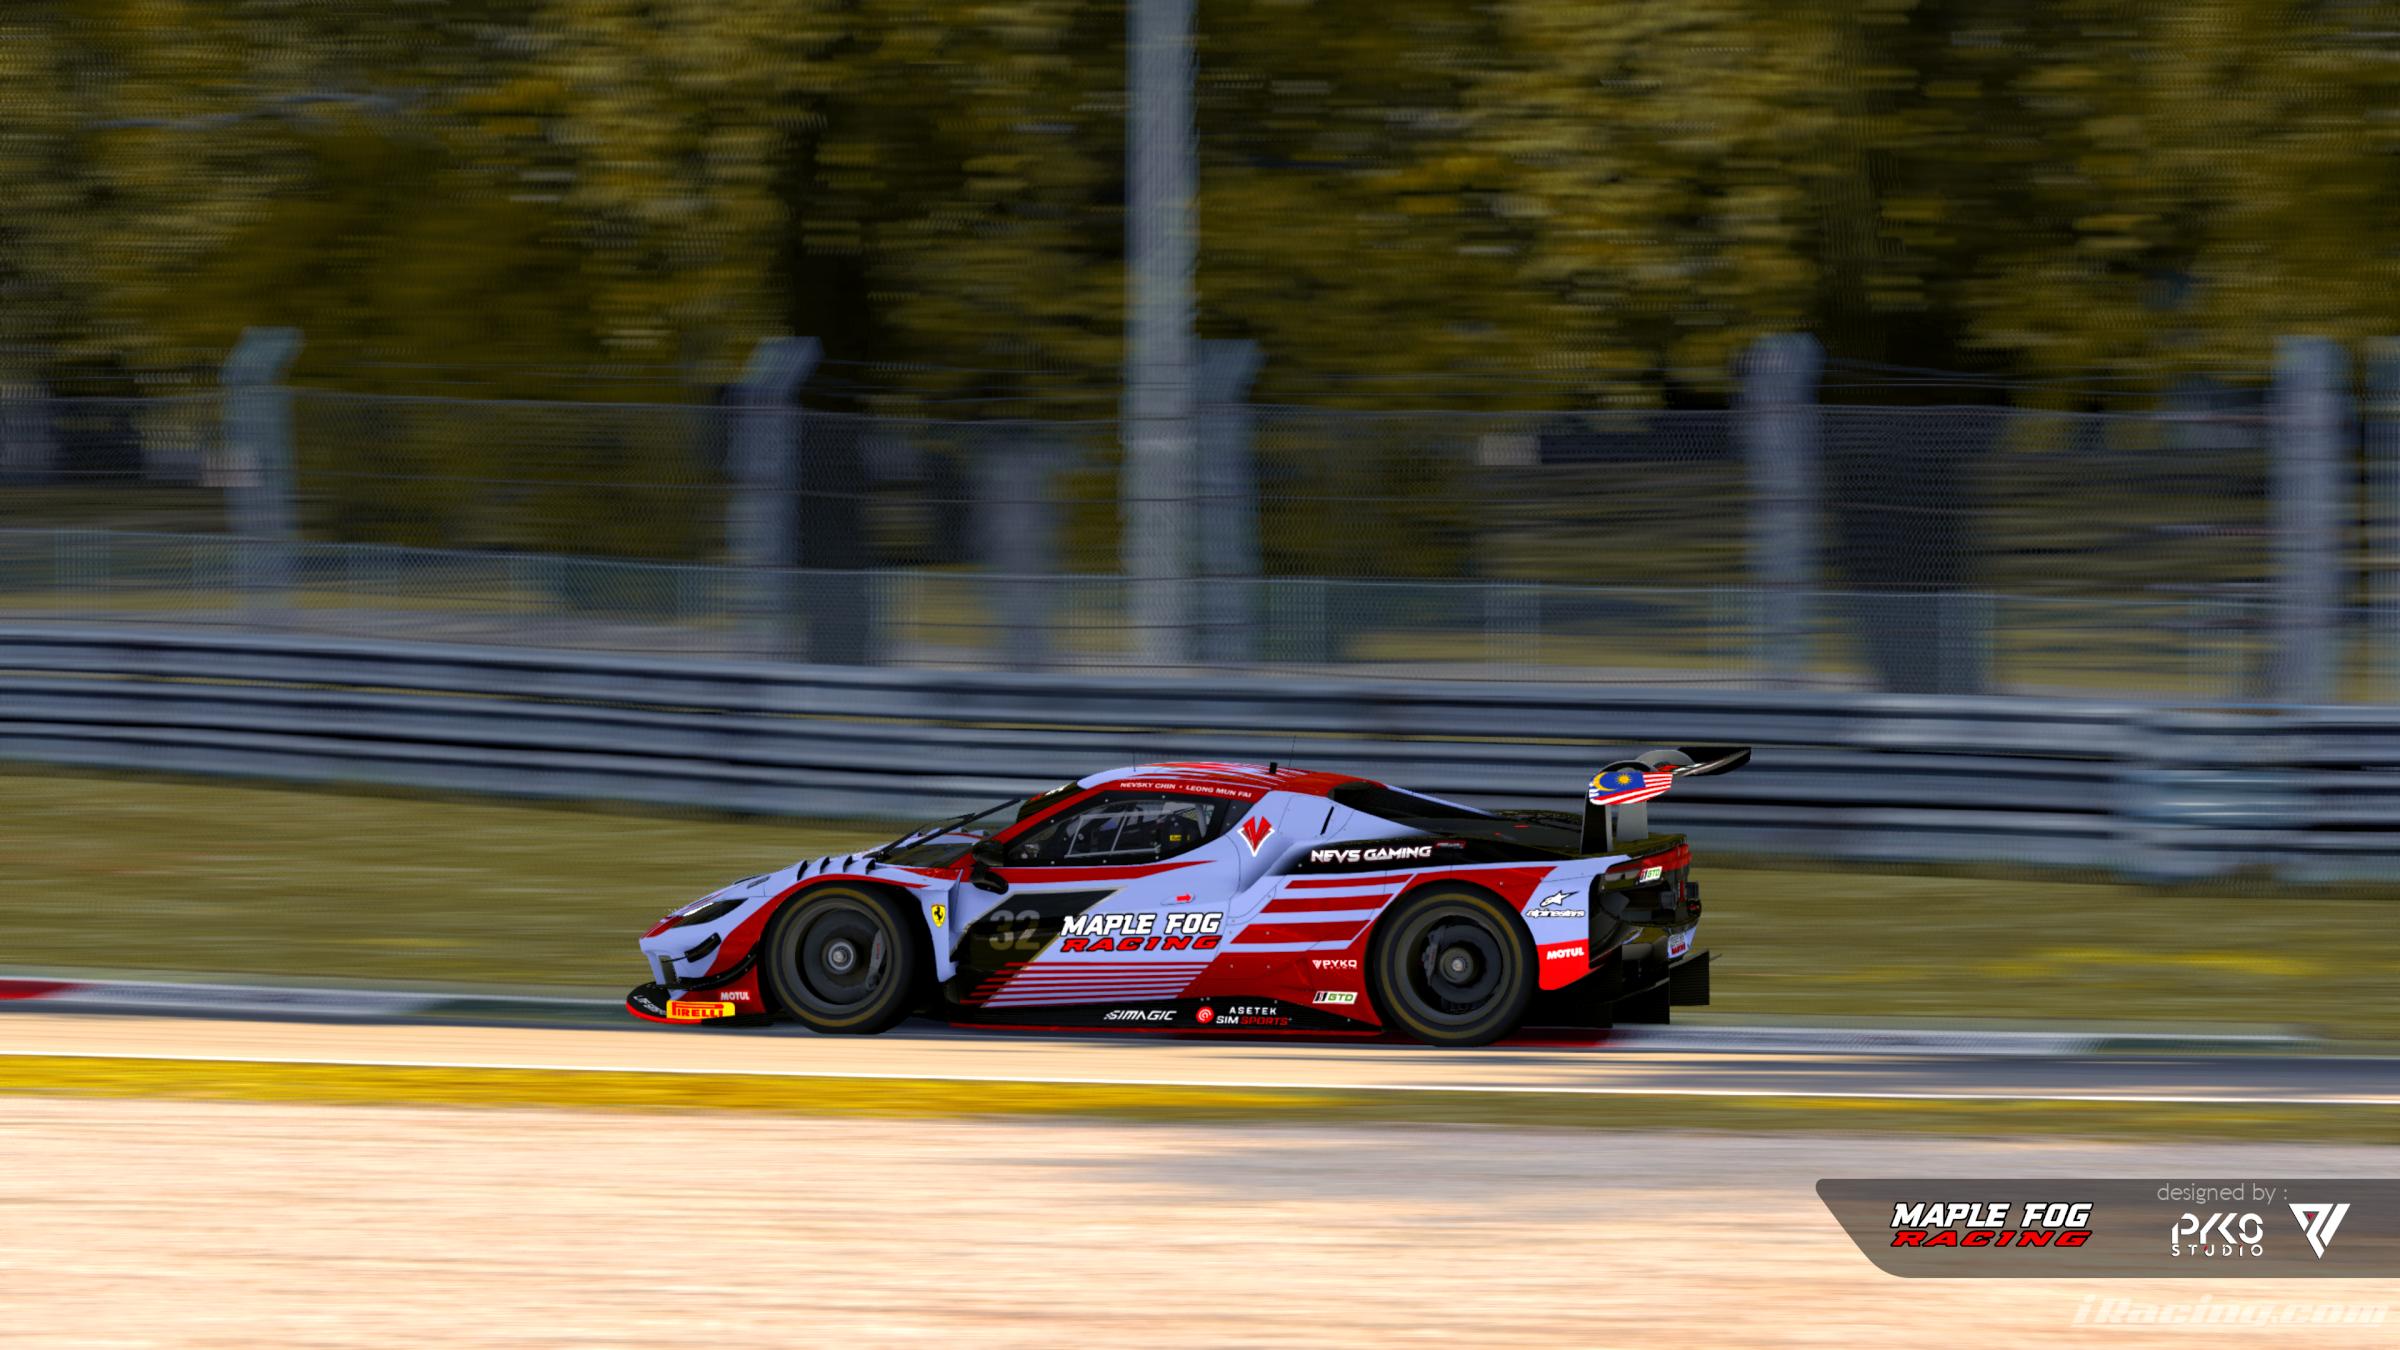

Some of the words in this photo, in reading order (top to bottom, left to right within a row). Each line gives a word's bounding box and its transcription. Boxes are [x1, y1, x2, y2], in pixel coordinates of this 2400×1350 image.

[1185, 785, 1214, 793] LEONG
[1215, 788, 1236, 796] MUN
[1311, 849, 1361, 863] NEVS
[1363, 846, 1432, 861] GAMING
[989, 910, 1040, 950] 32
[1060, 912, 1156, 936] MAPLE
[1164, 912, 1223, 935] FOG
[1060, 935, 1224, 952] RACING
[1546, 947, 1585, 961] MOTUL
[720, 991, 750, 1001] MOTUL
[671, 1001, 724, 1018] PIRELLI
[1103, 1010, 1177, 1021] SIMAGIC
[1229, 1006, 1277, 1015] ASETEK
[1216, 1015, 1239, 1024] SIM
[1241, 1017, 1289, 1026] SPORTS
